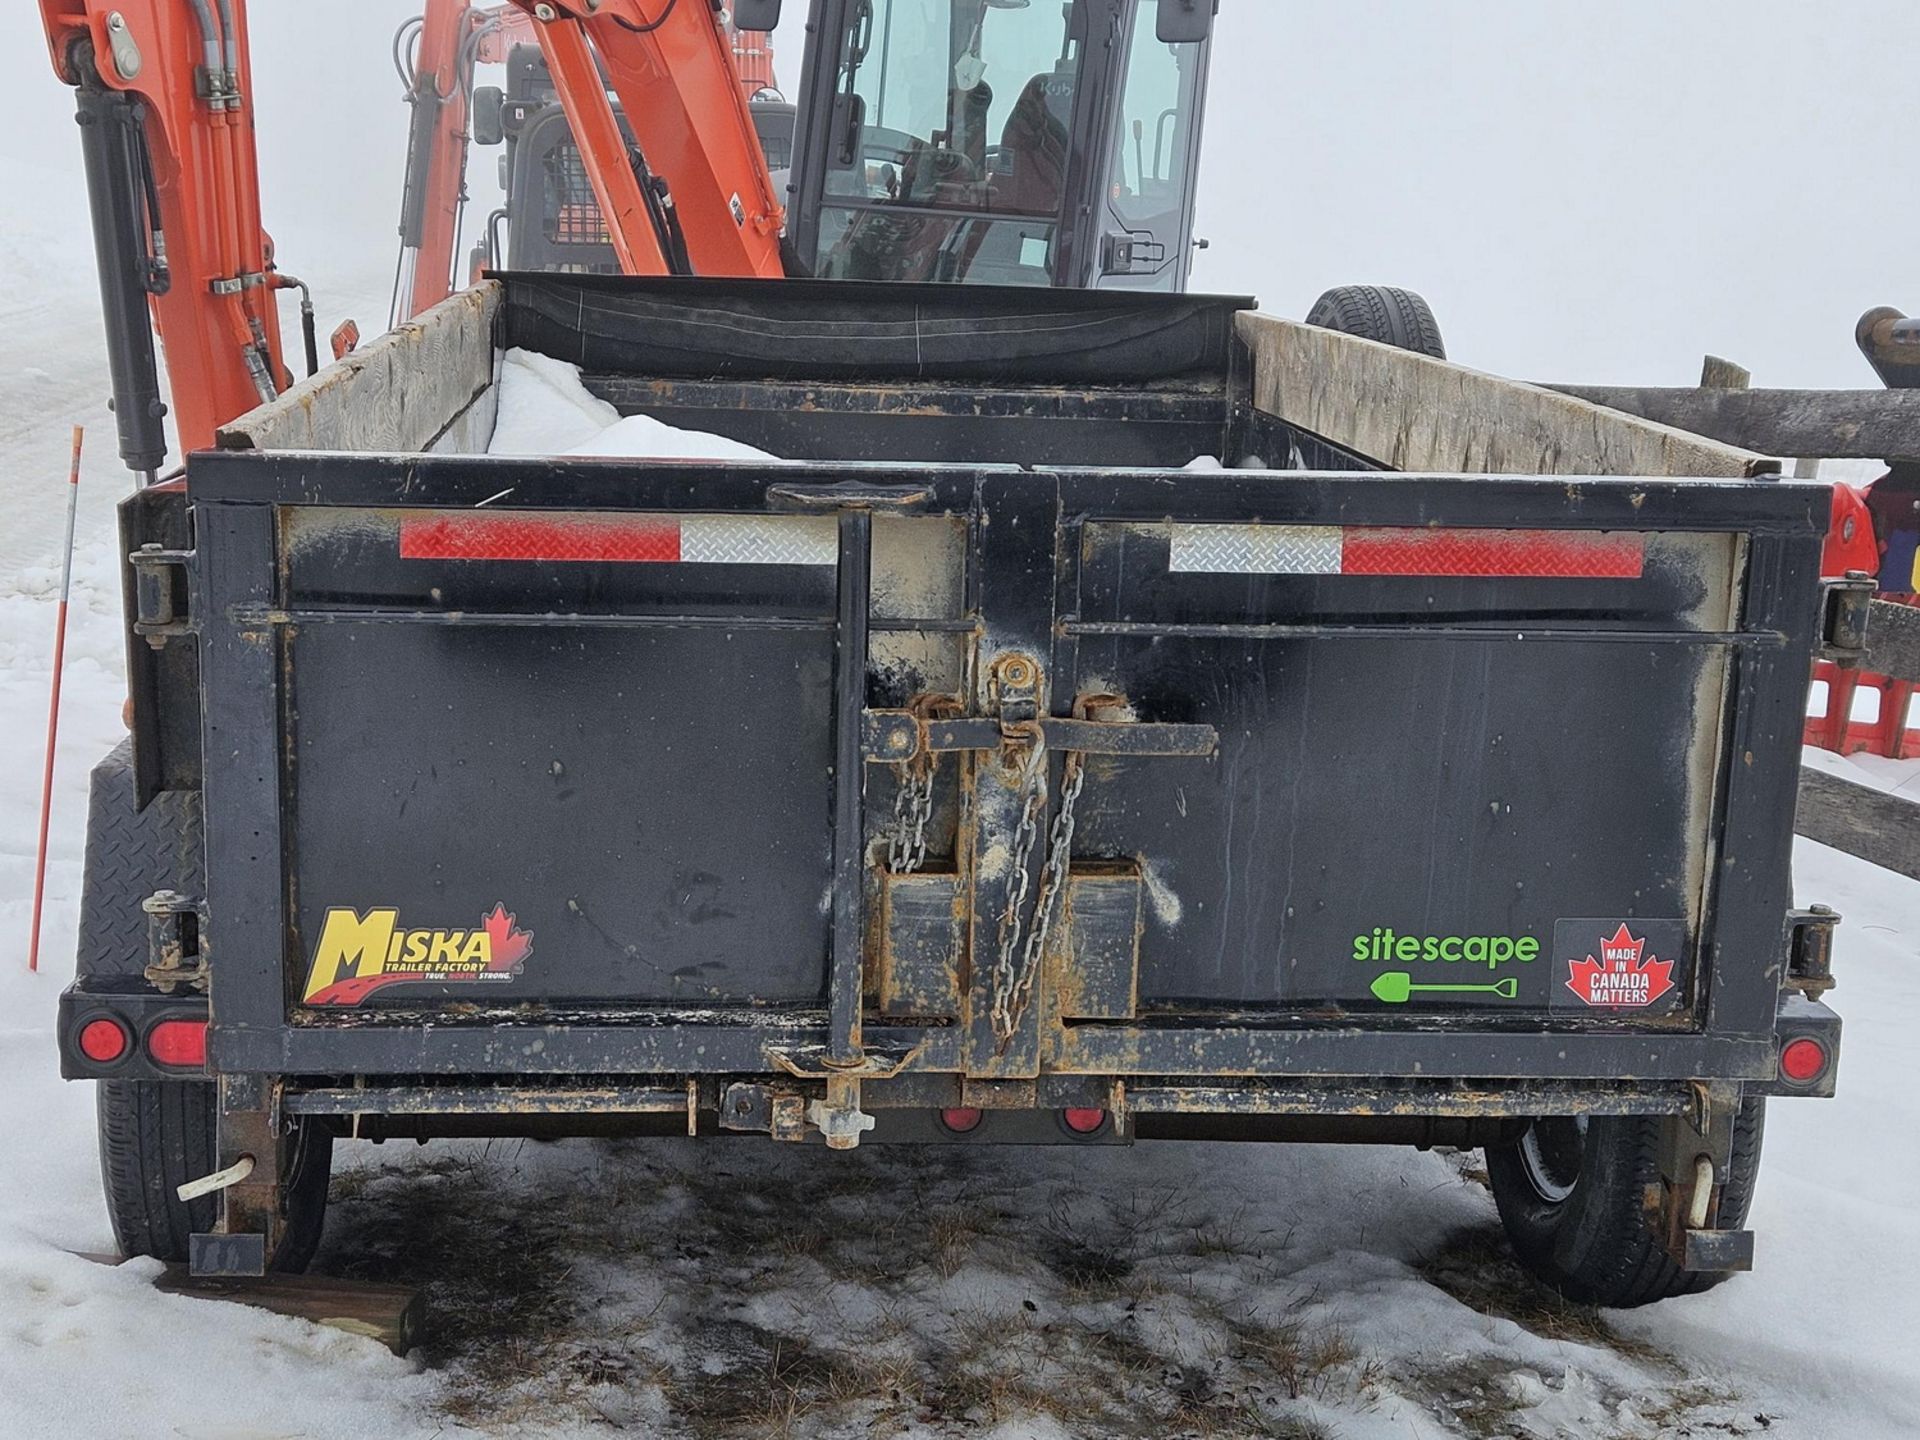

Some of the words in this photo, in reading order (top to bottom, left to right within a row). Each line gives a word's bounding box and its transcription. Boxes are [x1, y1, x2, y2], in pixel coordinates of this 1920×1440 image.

[303, 909, 492, 1002] MISKA
[1353, 927, 1540, 970] sitescape
[1606, 948, 1637, 960] MADE
[385, 963, 432, 972] TRAILER
[435, 963, 487, 972] FACTORY
[1615, 961, 1627, 972] IN
[1590, 973, 1650, 989] CANADA
[1590, 989, 1649, 1003] MATTERS
